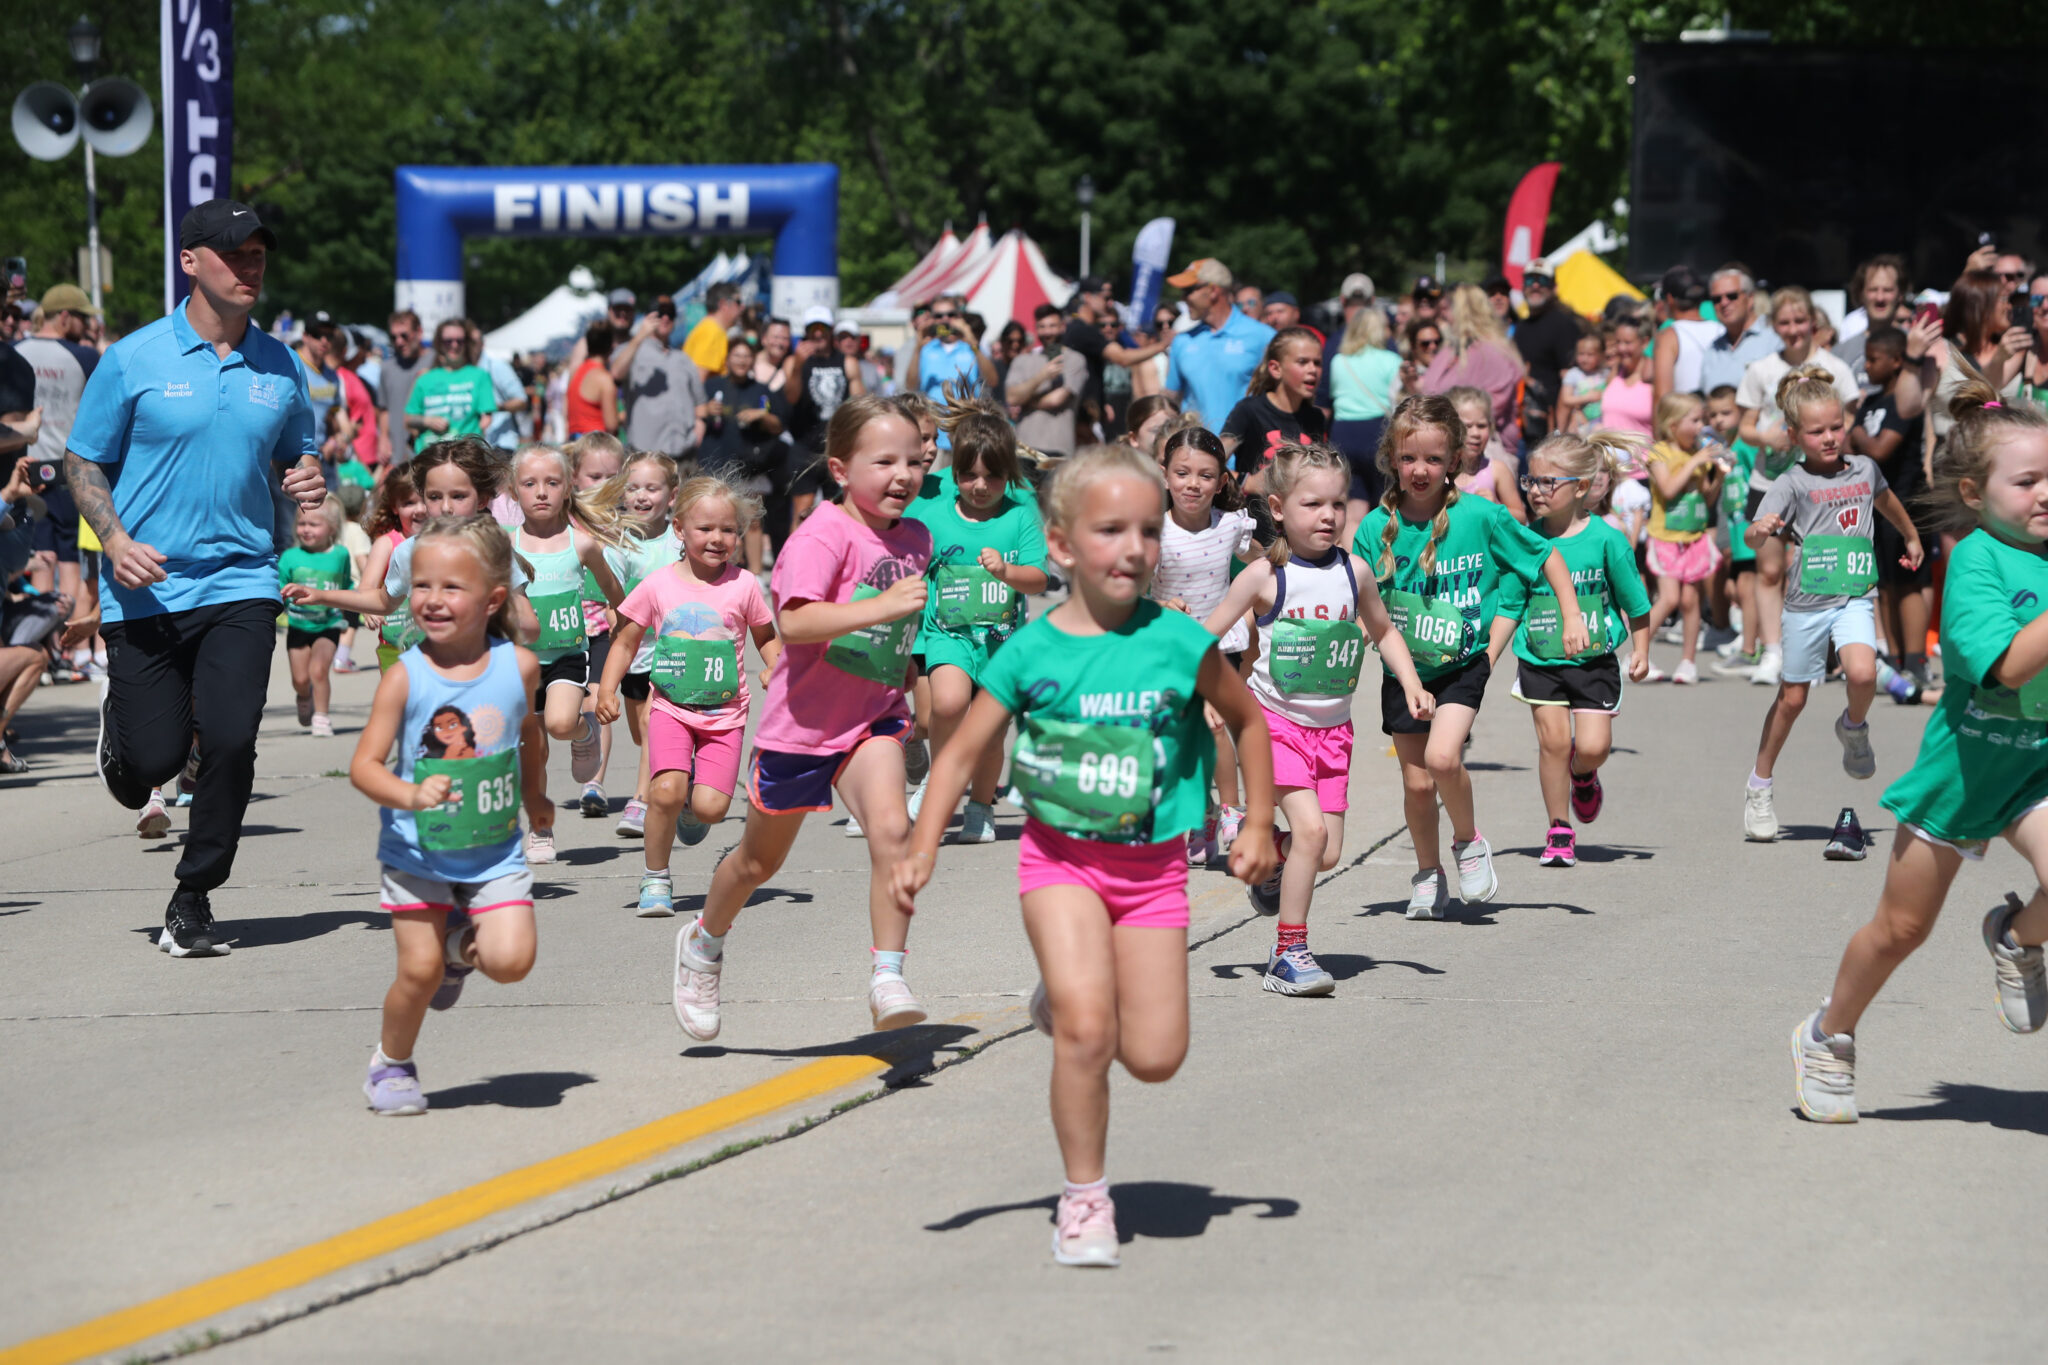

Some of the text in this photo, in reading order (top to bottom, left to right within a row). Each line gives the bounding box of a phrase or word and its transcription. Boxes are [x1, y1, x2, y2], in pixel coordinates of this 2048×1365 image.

[494, 182, 750, 231] FINISH
[164, 389, 193, 398] Member
[1809, 481, 1872, 504] WISCONSIN
[1838, 507, 1860, 531] W
[1428, 553, 1483, 576] ALLEYE
[1847, 551, 1873, 575] 927
[981, 582, 1008, 604] 106
[549, 606, 579, 632] 458
[1414, 613, 1457, 646] 1056
[1326, 639, 1359, 668] 347
[703, 656, 724, 682] 78
[1077, 751, 1139, 799] 699
[477, 772, 514, 815] 635
